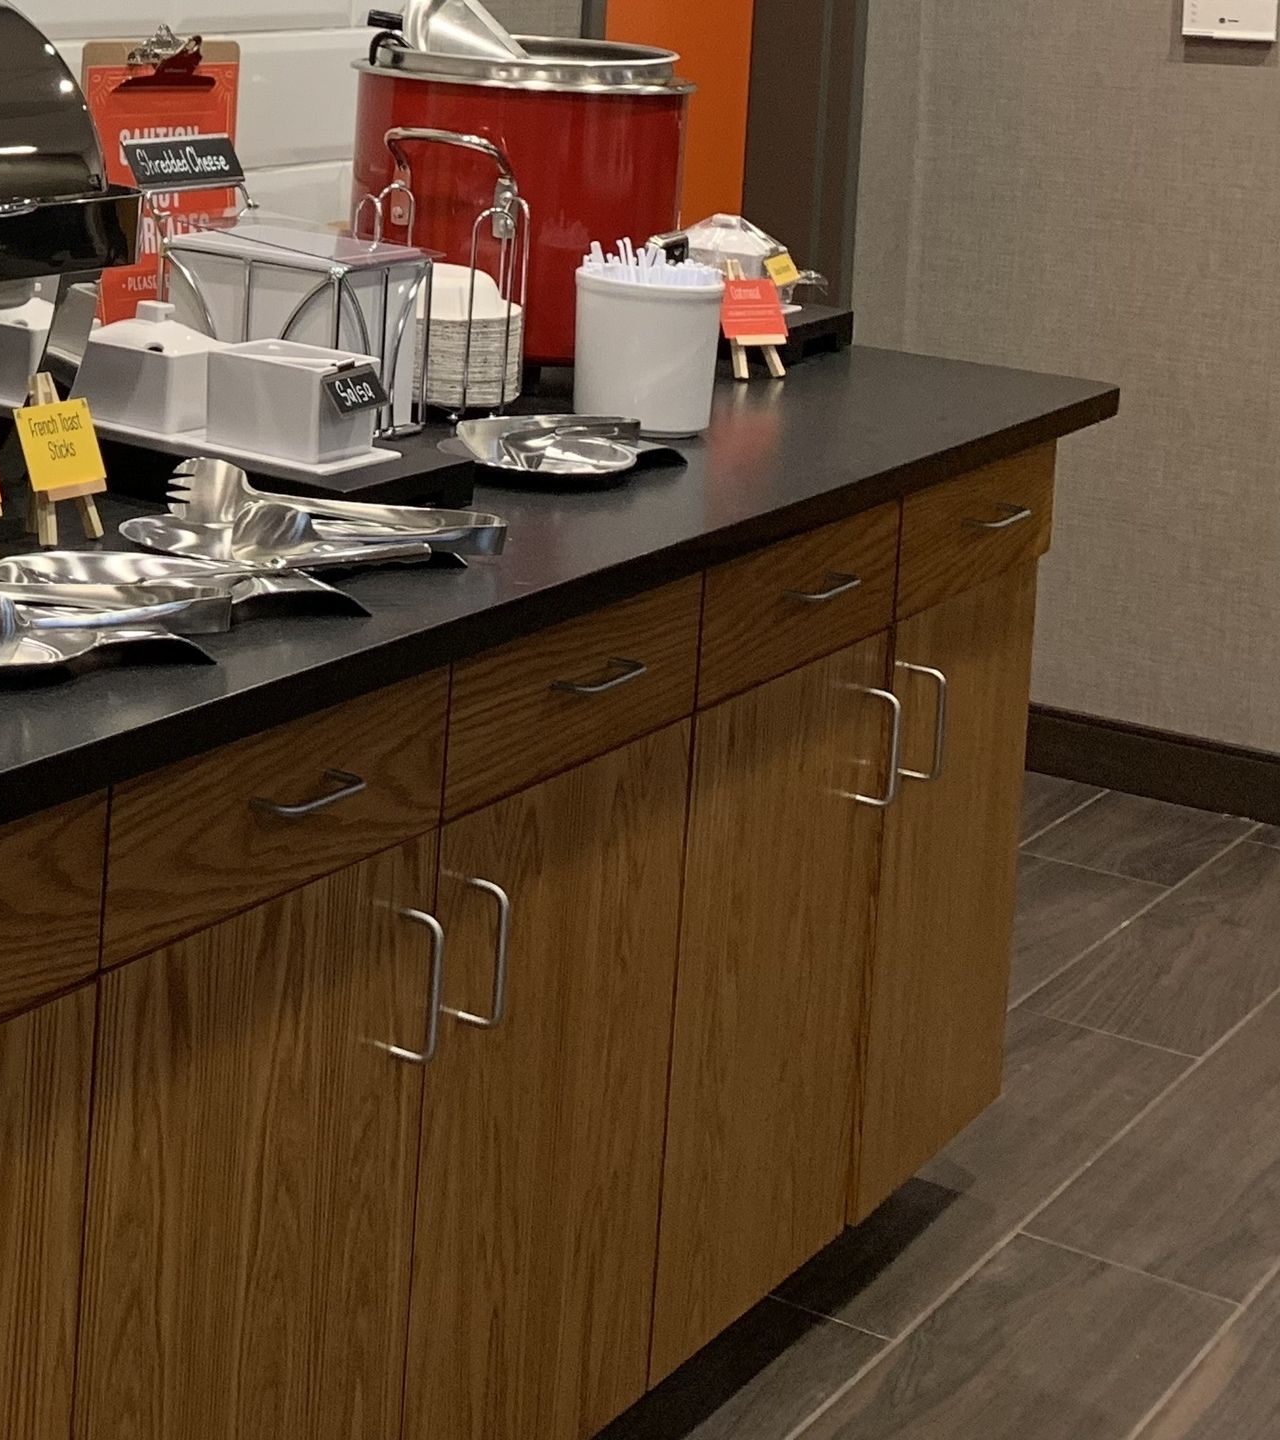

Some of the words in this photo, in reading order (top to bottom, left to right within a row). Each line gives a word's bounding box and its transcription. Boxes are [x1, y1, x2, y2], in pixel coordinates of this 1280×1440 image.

[135, 148, 191, 176] Shredded
[186, 146, 230, 174] Cheese
[335, 377, 376, 407] Salsa
[28, 414, 59, 438] French
[57, 411, 83, 433] Toast
[47, 438, 77, 461] Sticks
